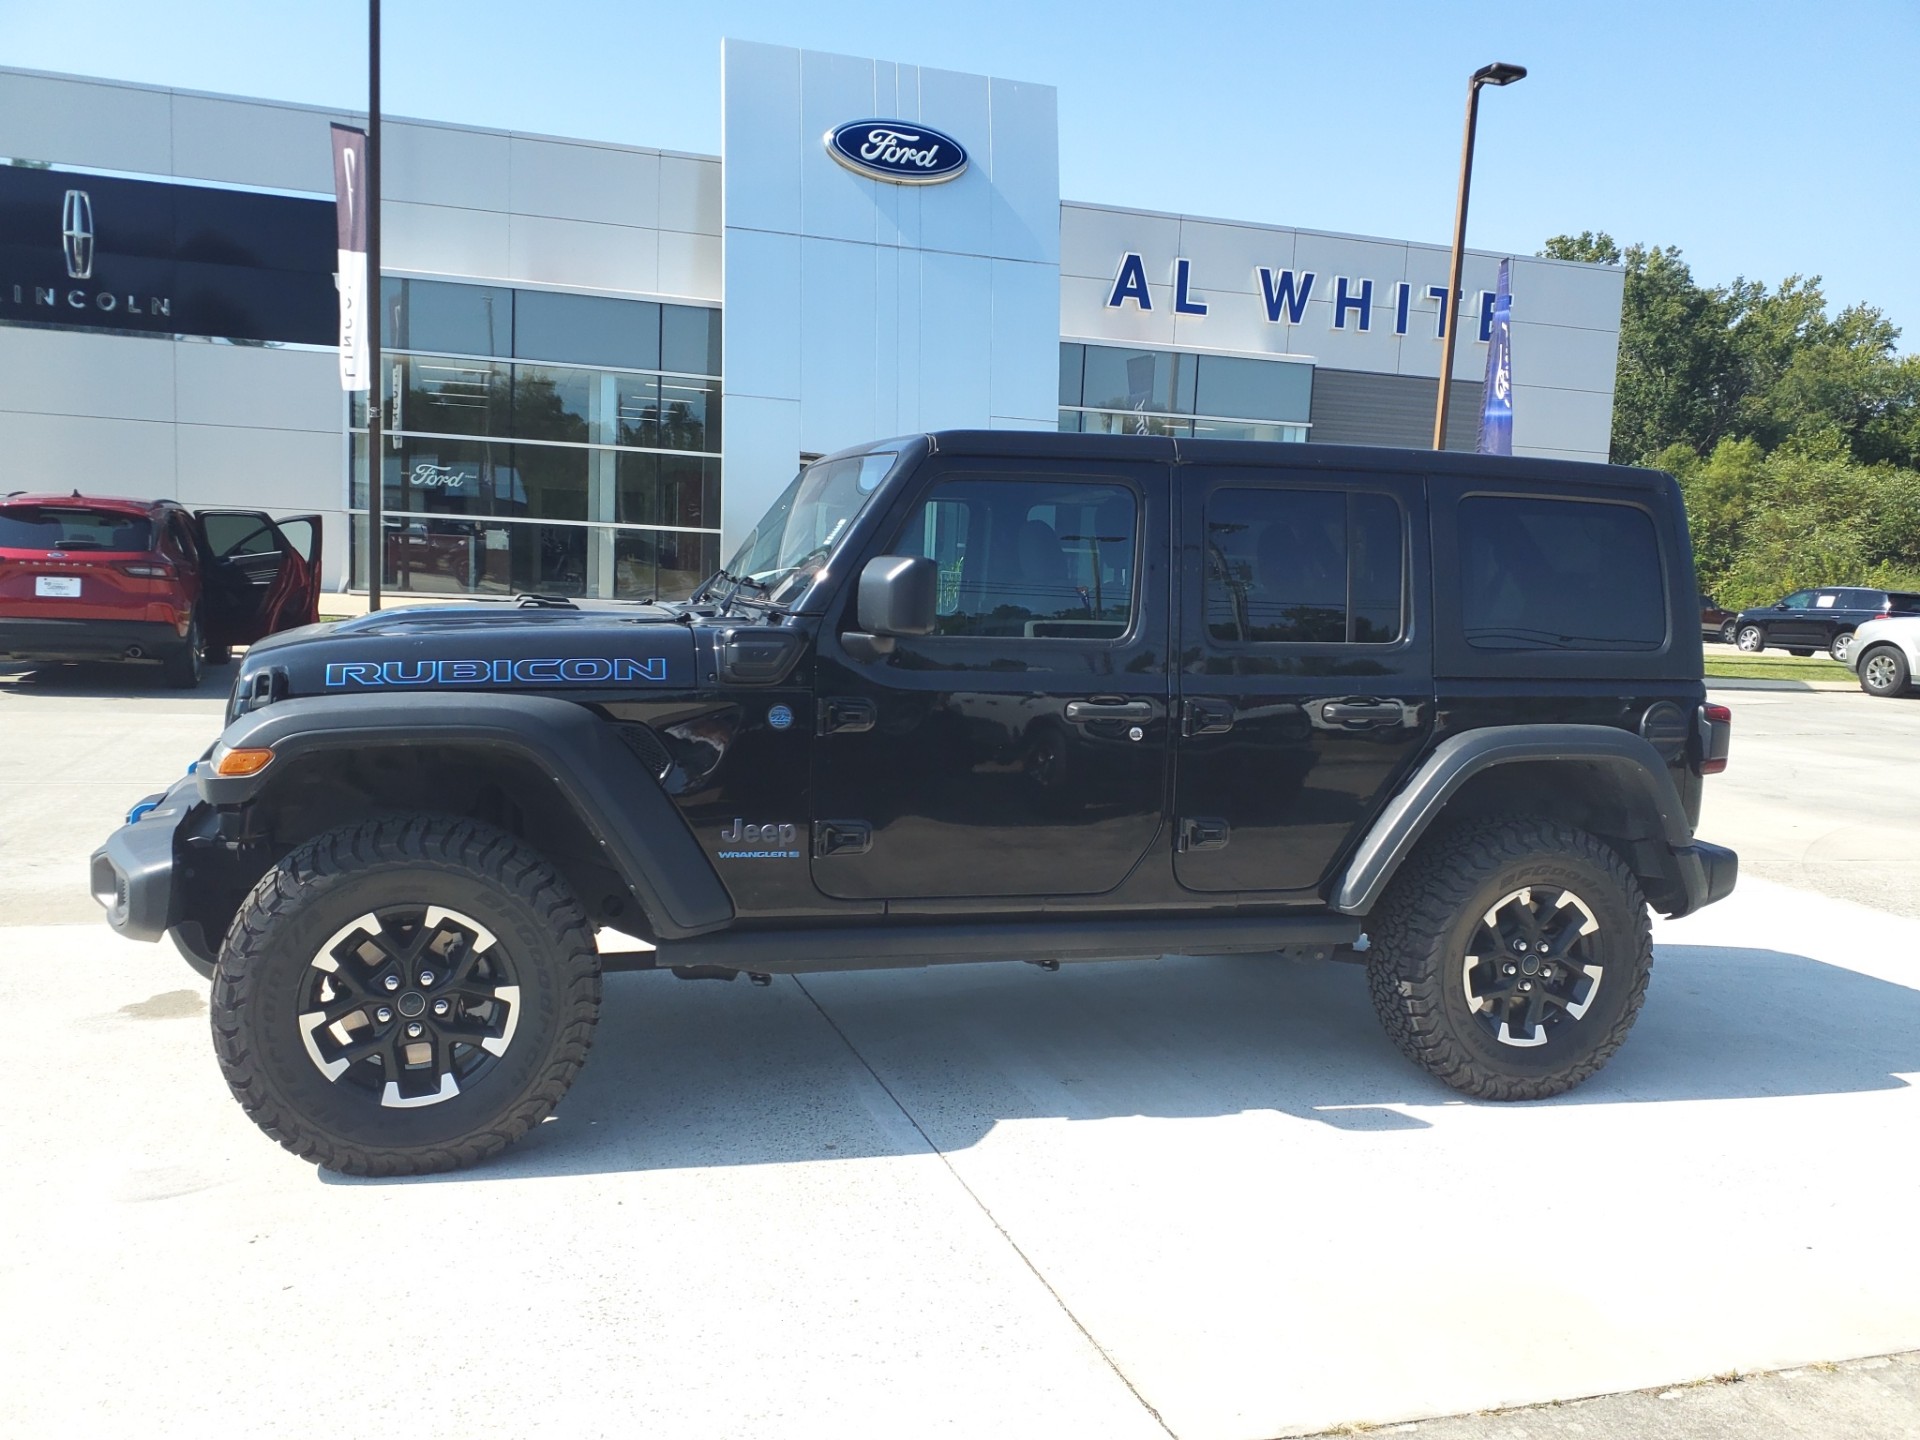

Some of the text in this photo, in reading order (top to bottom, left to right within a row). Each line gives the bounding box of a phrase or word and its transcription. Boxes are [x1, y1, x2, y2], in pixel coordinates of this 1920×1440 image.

[860, 129, 939, 168] Ford
[0, 284, 171, 317] INCOLN
[1106, 252, 1515, 343] AL WHITE
[410, 463, 465, 487] Ford
[325, 658, 667, 686] RUBICON
[721, 818, 797, 847] Jeep
[718, 850, 787, 858] WRANGLER
